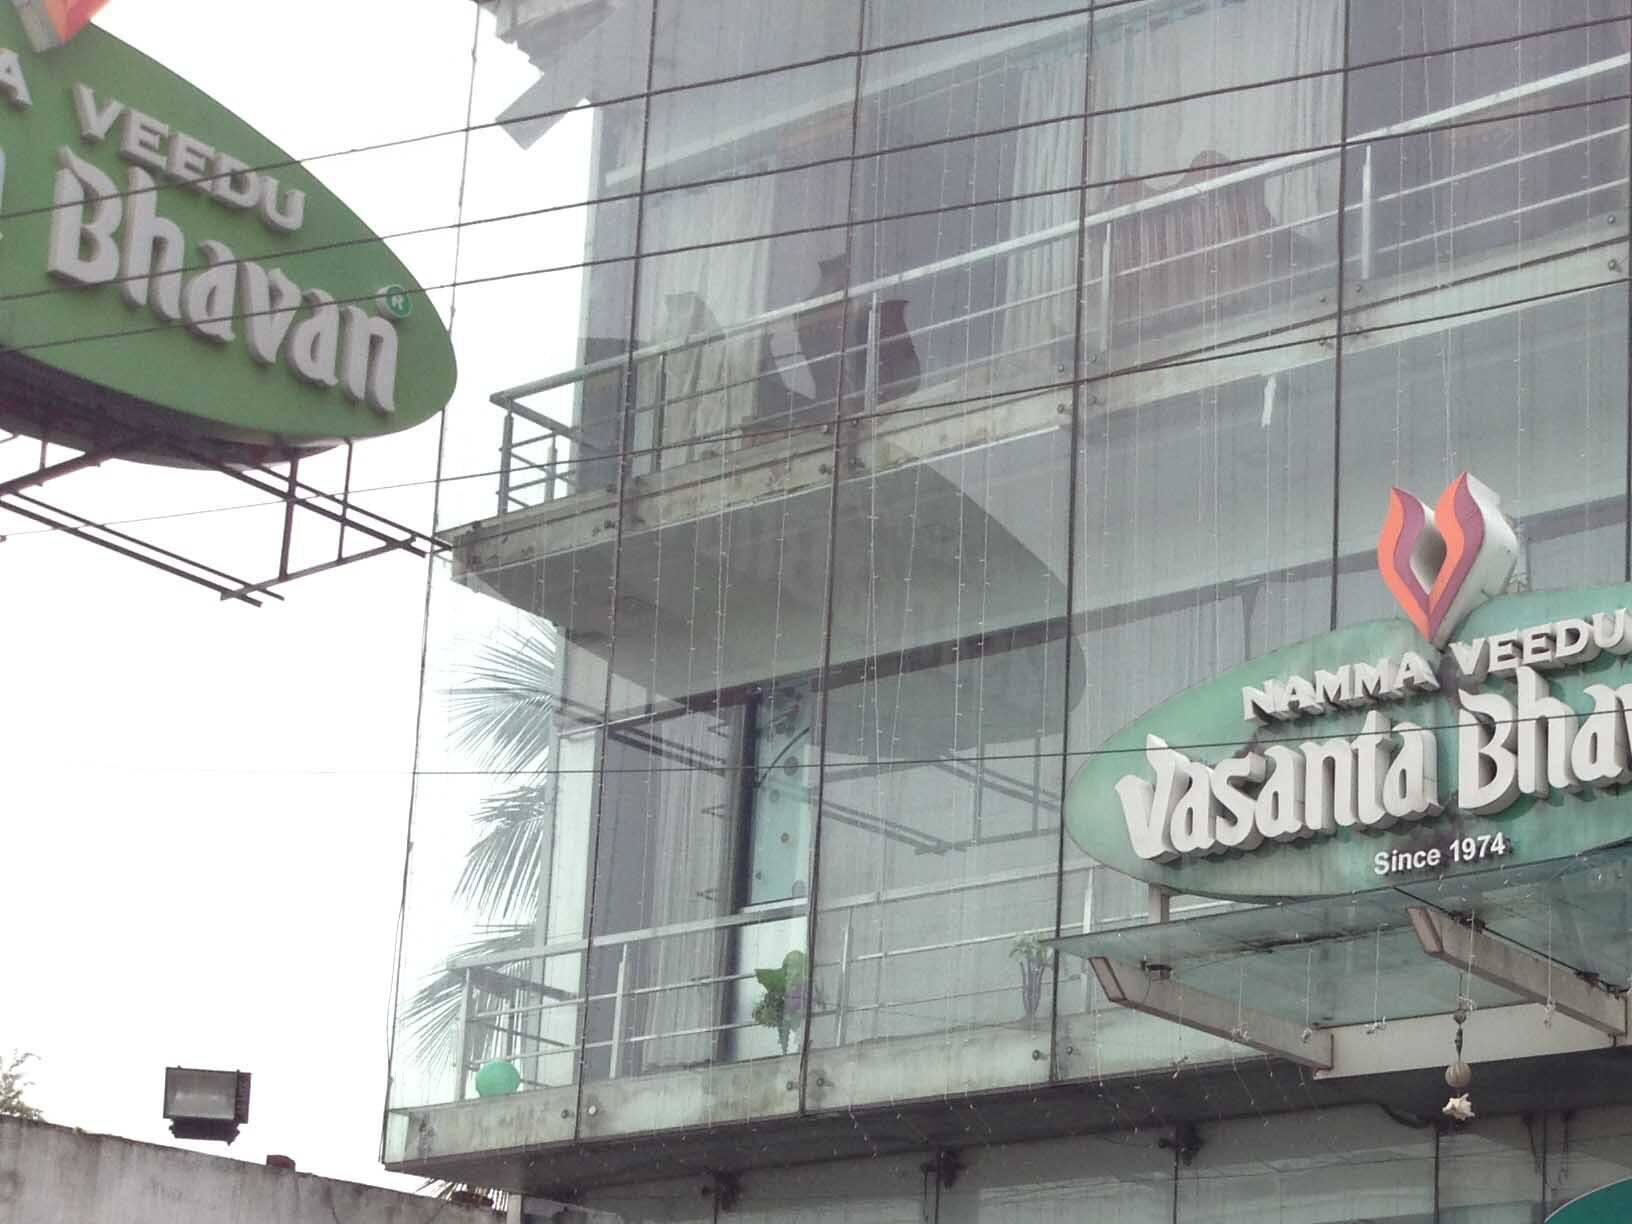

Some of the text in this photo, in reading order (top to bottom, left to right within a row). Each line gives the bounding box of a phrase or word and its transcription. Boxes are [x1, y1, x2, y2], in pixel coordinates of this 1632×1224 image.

[74, 81, 305, 231] VEEDU
[47, 144, 398, 413] Bhavan
[1242, 650, 1440, 720] NAMMA
[1114, 710, 1442, 862] Vasanta
[1374, 832, 1506, 875] Since 1974
